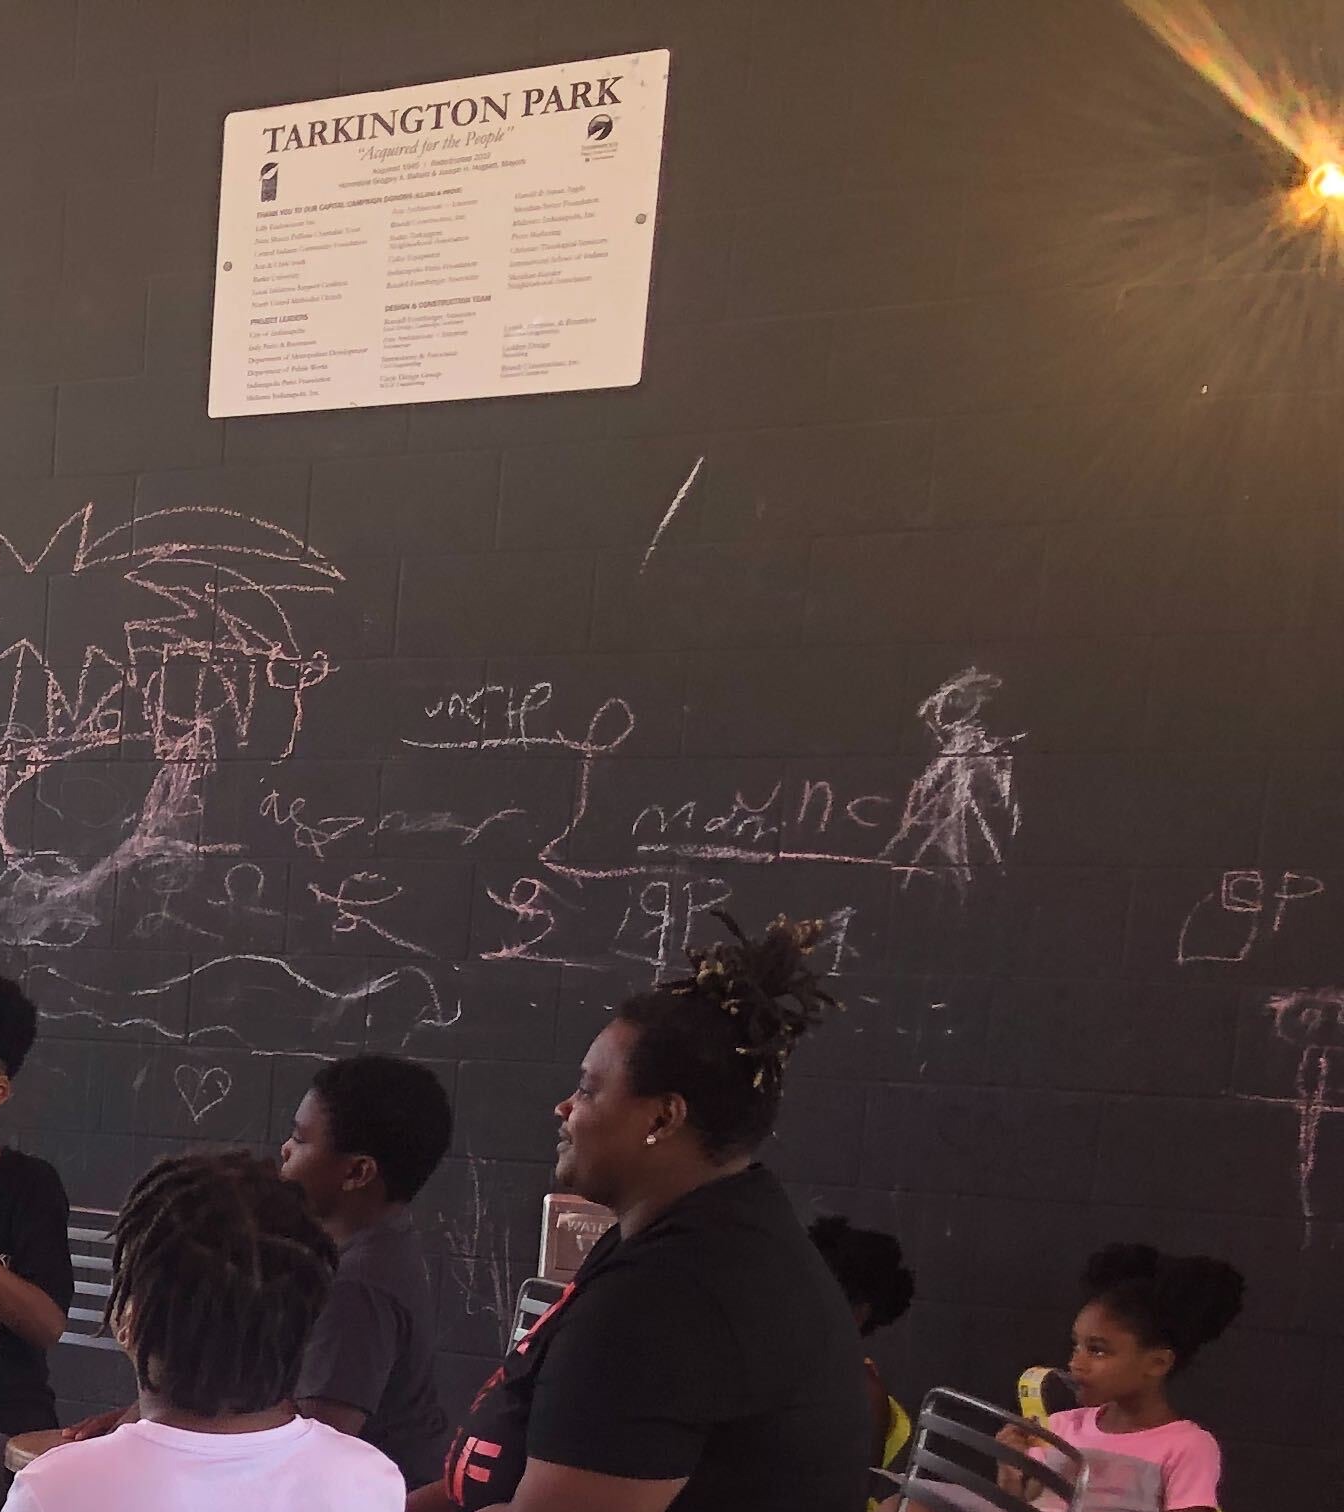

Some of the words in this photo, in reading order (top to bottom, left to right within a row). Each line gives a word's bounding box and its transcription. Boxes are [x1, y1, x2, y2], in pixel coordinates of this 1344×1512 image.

[263, 93, 511, 153] TARKINGTON
[521, 75, 623, 118] PARK
[417, 138, 438, 158] for
[442, 136, 461, 150] the
[567, 1220, 614, 1233] WATE
